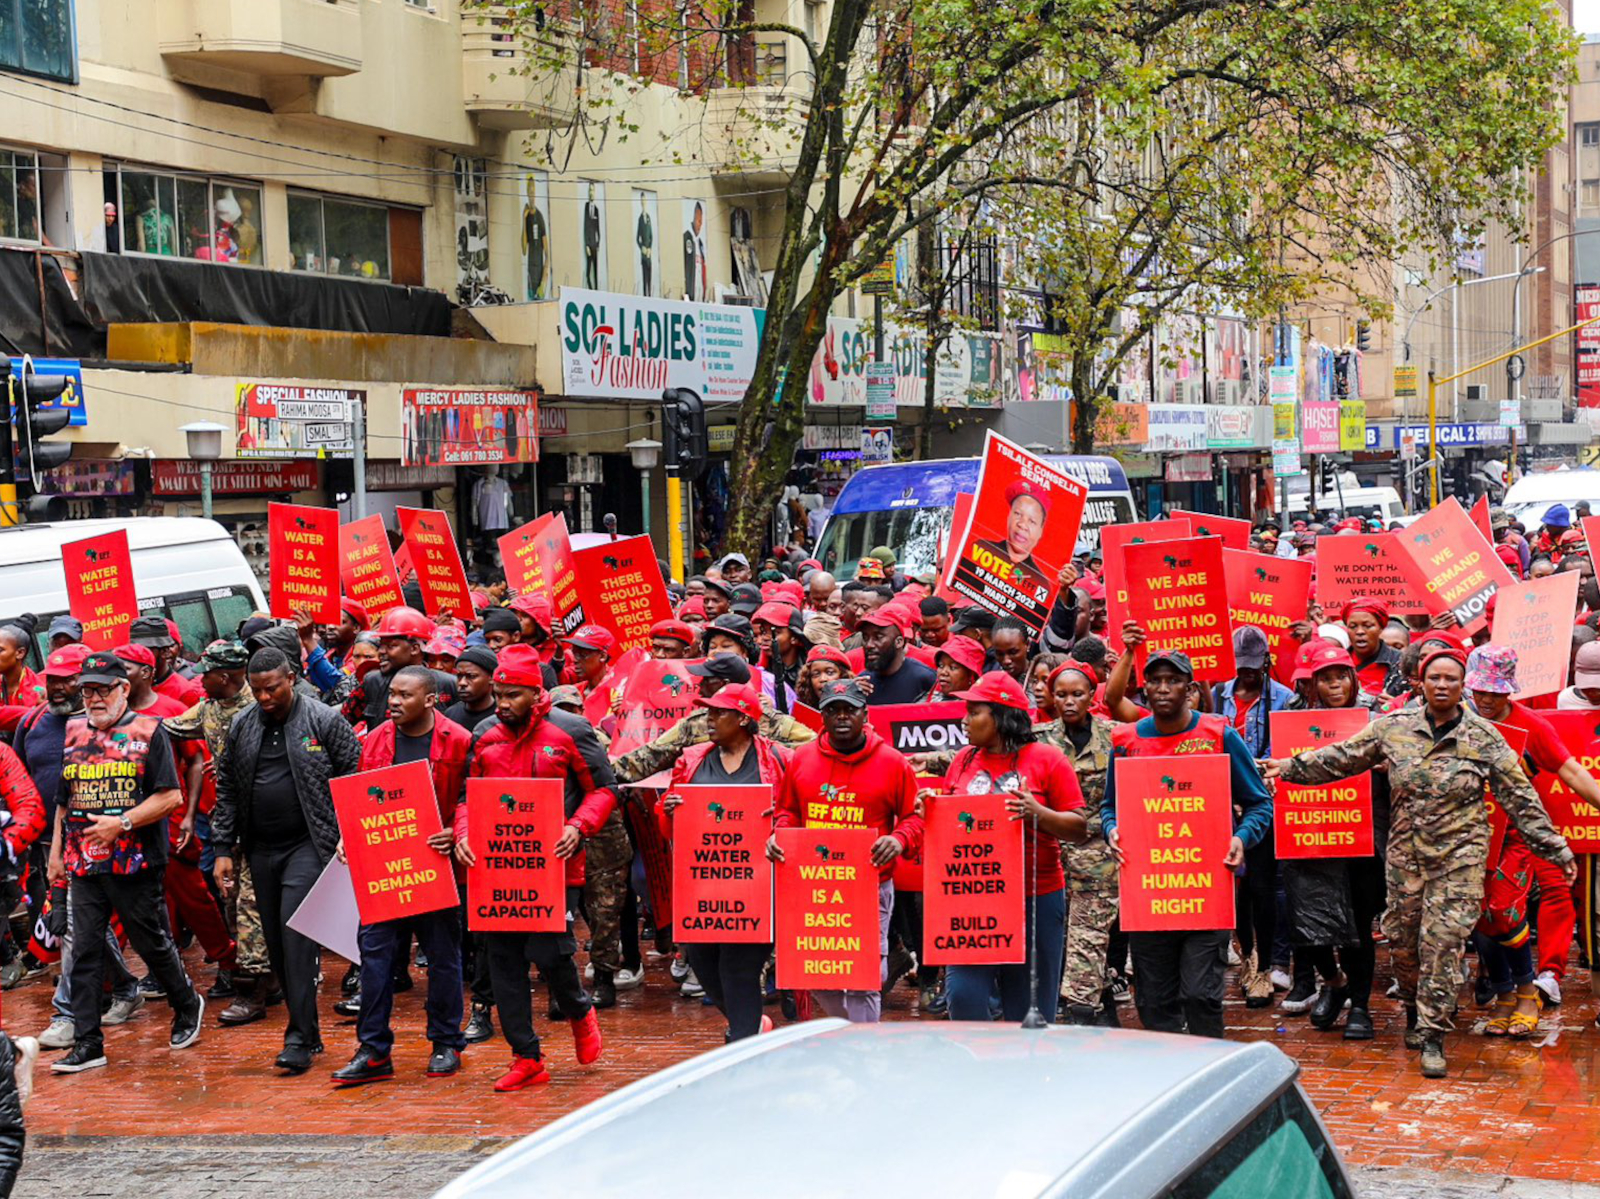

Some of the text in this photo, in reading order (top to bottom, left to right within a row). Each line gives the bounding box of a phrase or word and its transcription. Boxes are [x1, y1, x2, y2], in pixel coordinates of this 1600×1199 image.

[565, 302, 697, 362] SOL LADIES
[590, 325, 669, 390] Fashion
[256, 386, 348, 405] SPECIAL FASHION
[416, 392, 526, 406] MERCY LADIES FASHION
[281, 402, 341, 418] RAHIMA MOOSA STR
[1304, 407, 1338, 431] HASET
[309, 426, 332, 441] SMAL
[445, 451, 504, 462] Cell: 061 780 3534
[176, 461, 282, 474] WELOME TO NEW
[996, 442, 1033, 472] TSILALE
[1034, 462, 1080, 497] CONSELIA
[1020, 466, 1052, 491] SEIMA
[284, 531, 324, 546] WATER
[415, 533, 445, 545] WATER
[293, 549, 316, 562] IS A
[347, 544, 380, 562] WE ARE
[426, 549, 444, 560] IS A
[1430, 547, 1454, 566] WE
[524, 557, 534, 566] IS
[554, 558, 563, 573] WE
[971, 543, 1014, 580] VOTE
[1334, 564, 1383, 572] WE DON'T
[79, 565, 118, 583] WATER
[288, 565, 322, 579] BASIC
[352, 561, 382, 578] LIVING
[427, 565, 452, 577] BASIC
[1425, 551, 1481, 593] DEMAND
[82, 578, 119, 595] IS LIFE
[352, 575, 391, 595] WITH NO
[429, 580, 461, 593] HUMAN
[552, 570, 575, 596] DEMAND
[601, 571, 644, 590] THERE
[1022, 580, 1036, 592] EFF
[1146, 572, 1207, 590] WE ARE
[1335, 576, 1369, 584] WATER
[1442, 569, 1486, 603] WATER
[283, 582, 328, 597] HUMAN
[601, 583, 653, 603] SHOULD
[975, 566, 1036, 610] 19 MARCH 2025
[1398, 588, 1406, 596] A
[436, 595, 461, 608] RIGHT
[558, 589, 578, 611] WATER
[954, 581, 999, 613] JOHANNESBURG
[983, 585, 1017, 611] WARD 59
[1153, 594, 1206, 611] LIVING
[1250, 591, 1273, 607] WE
[1454, 584, 1497, 623] NOW
[94, 603, 114, 616] WE
[288, 598, 323, 613] RIGHT
[611, 597, 650, 615] BE NO
[82, 613, 130, 632] DEMAND
[564, 604, 584, 632] NOW
[615, 609, 653, 627] PRICE
[1147, 613, 1217, 632] WITH NO
[1230, 608, 1291, 629] DEMAND
[1516, 612, 1549, 625] STOP
[103, 629, 113, 640] IT
[625, 624, 651, 638] FOR
[1508, 624, 1553, 639] WATER
[1146, 634, 1223, 653] FLUSHING
[643, 707, 687, 720] DON'T
[130, 741, 147, 751] EFF
[79, 762, 137, 780] GAUTENG
[72, 778, 137, 794] ARCH TO
[1178, 782, 1193, 791] EFF
[1550, 780, 1563, 794] A
[99, 791, 130, 800] WATER
[388, 788, 405, 800] EFF
[1287, 788, 1357, 803] WITH NO
[105, 799, 136, 807] WATER
[519, 802, 535, 812] EFF
[1143, 797, 1205, 813] WATER
[360, 808, 417, 830] WATER
[727, 811, 744, 821] EFF
[807, 802, 864, 823] EFF 10TH
[1284, 810, 1362, 825] FLUSHING
[494, 823, 535, 837] STOP
[977, 819, 994, 831] EFF
[1158, 823, 1193, 838] IS A
[366, 824, 419, 845] IS LIFE
[702, 833, 743, 846] STOP
[1293, 832, 1355, 847] TOILETS
[488, 840, 542, 853] WATER
[952, 844, 994, 859] STOP
[484, 857, 546, 869] TENDER
[694, 850, 750, 863] WATER
[832, 852, 846, 860] EFF
[1150, 848, 1202, 864] BASIC
[385, 857, 413, 874] WE
[799, 865, 856, 881] WATER
[945, 862, 1002, 877] WATER
[690, 867, 754, 880] TENDER
[1142, 873, 1212, 889] HUMAN
[367, 869, 438, 894] DEMAND
[941, 880, 1005, 895] TENDER
[399, 890, 413, 904] IT
[492, 889, 539, 902] BUILD
[812, 889, 844, 904] IS A
[477, 906, 554, 918] CAPACITY
[698, 900, 745, 914] BUILD
[1151, 898, 1205, 914] RIGHT
[682, 917, 761, 931] CAPACITY
[804, 913, 852, 928] BASIC
[950, 916, 998, 931] BUILD
[796, 936, 861, 951] HUMAN
[934, 934, 1013, 950] CAPACITY
[804, 960, 854, 974] RIGHT
